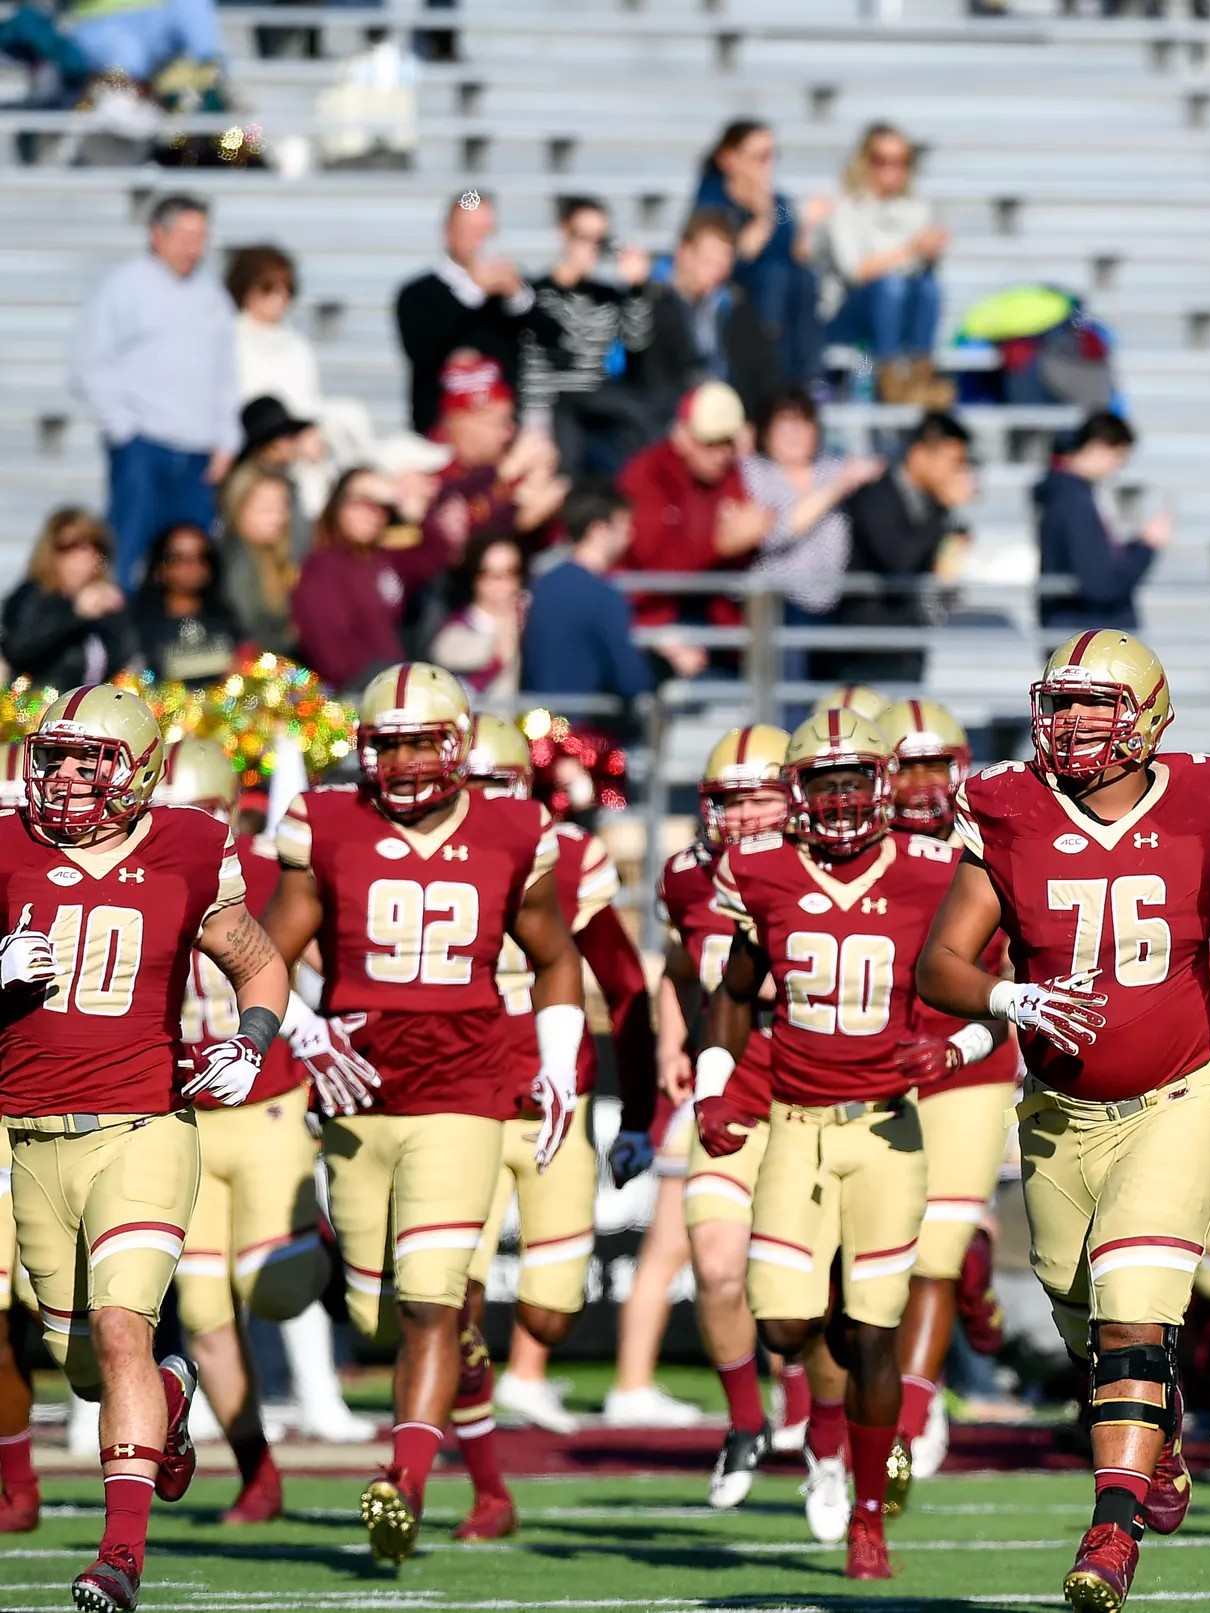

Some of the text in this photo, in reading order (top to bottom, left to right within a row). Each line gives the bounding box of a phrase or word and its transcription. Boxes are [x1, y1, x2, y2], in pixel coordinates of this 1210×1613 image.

[52, 871, 78, 880] ACC
[1059, 838, 1082, 846] ACC
[43, 904, 144, 1017] 10
[365, 878, 480, 986] 92
[784, 931, 896, 1037] 20
[1047, 874, 1172, 994] 76
